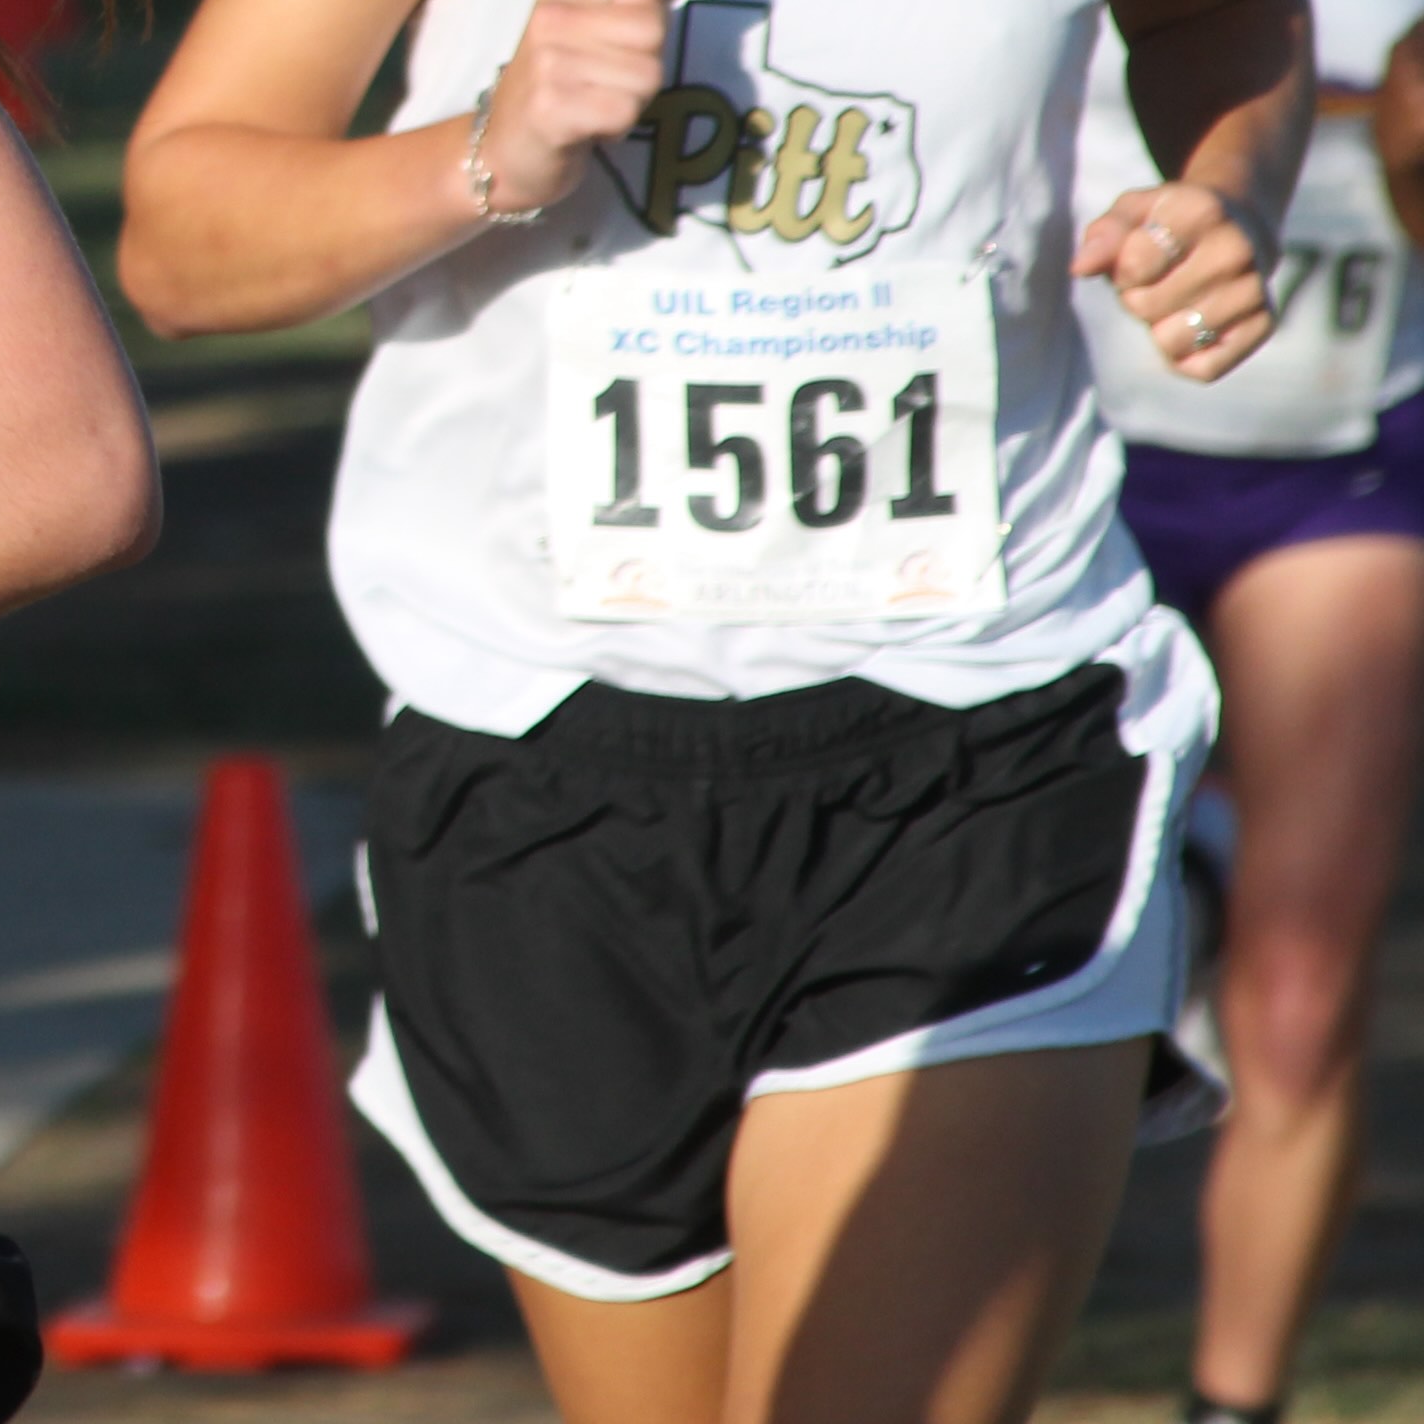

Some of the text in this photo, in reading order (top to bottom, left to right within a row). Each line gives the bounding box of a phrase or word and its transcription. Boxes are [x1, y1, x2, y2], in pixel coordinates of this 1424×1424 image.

[634, 84, 875, 246] Pitt
[609, 321, 938, 360] XC Championship
[652, 281, 893, 320] UIL Region II
[592, 369, 958, 533] 1561
